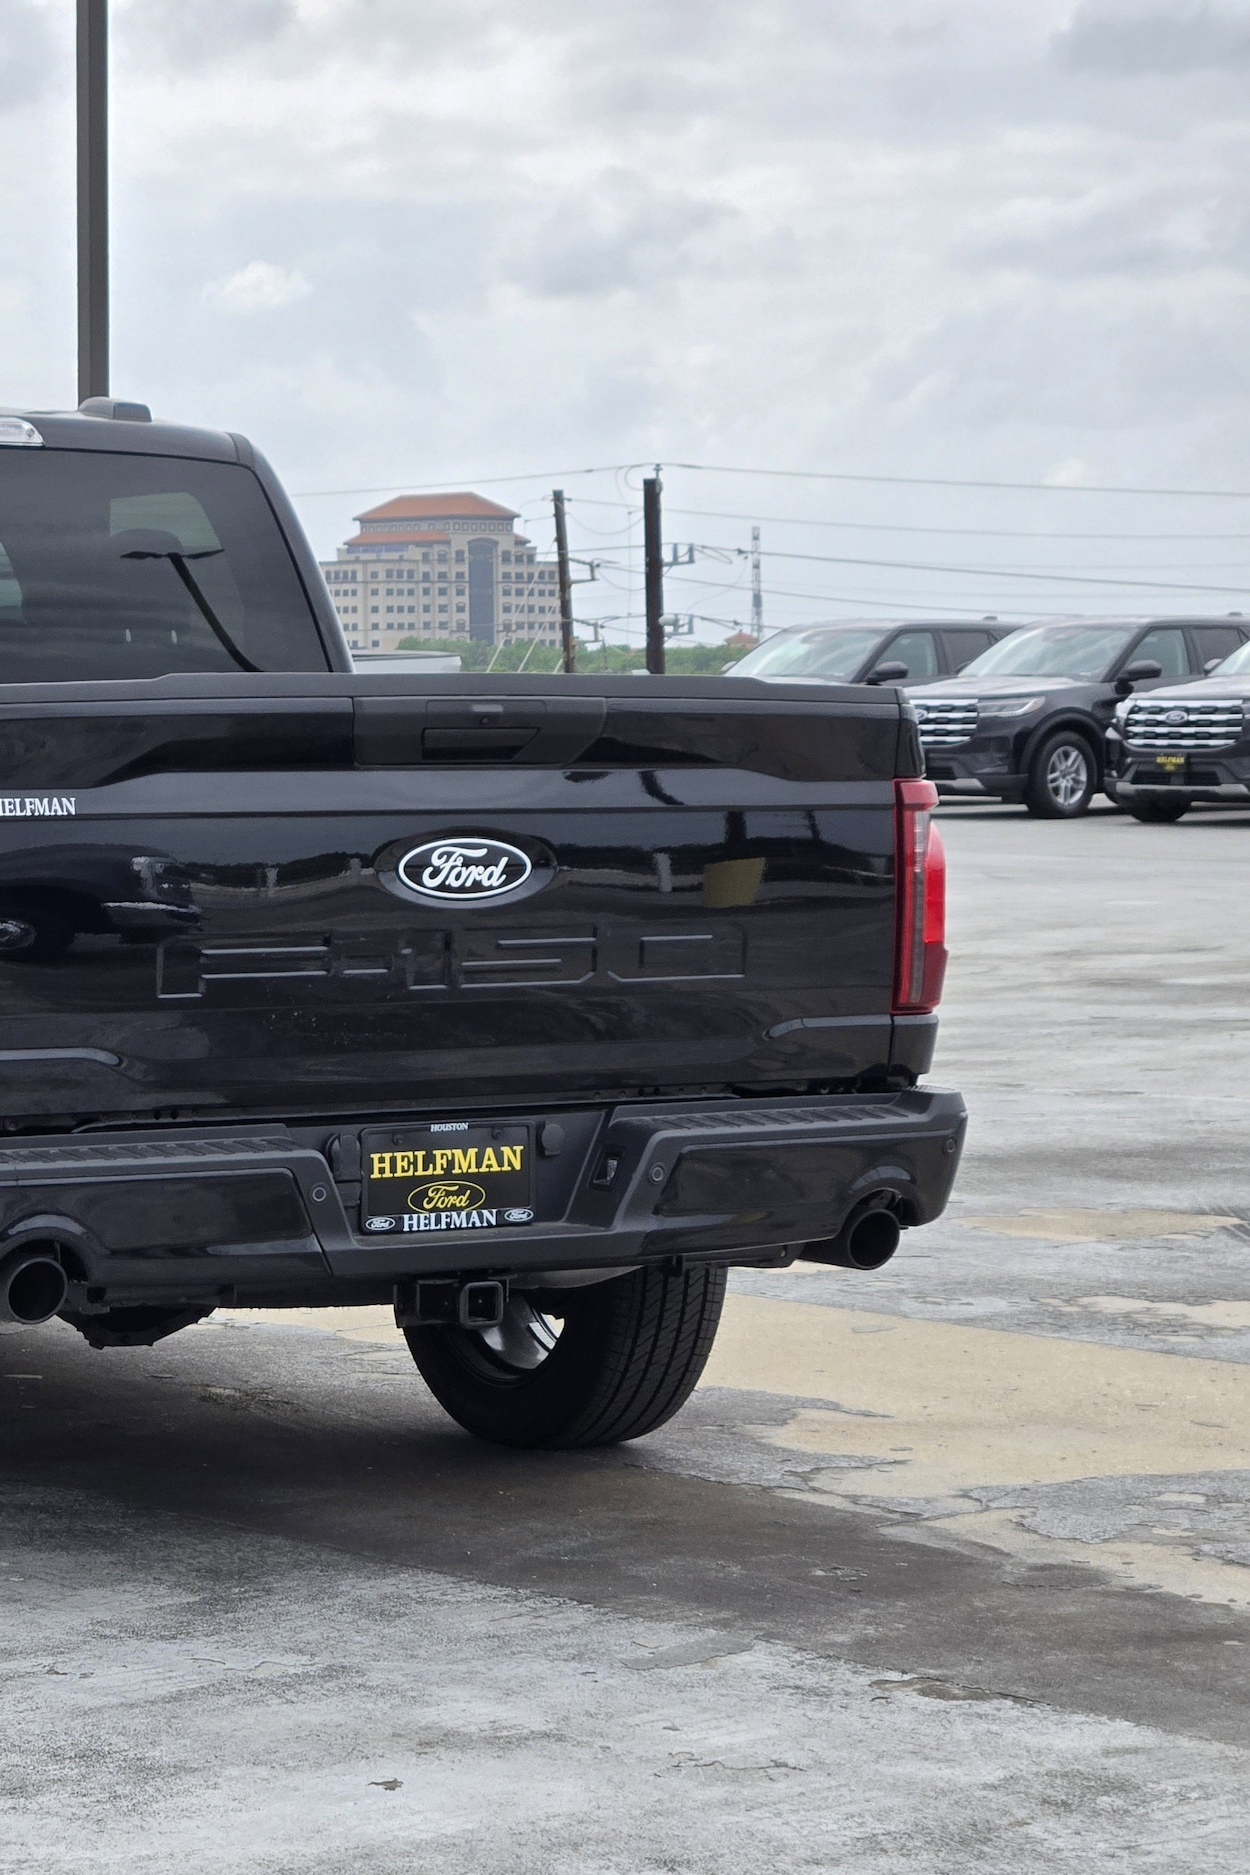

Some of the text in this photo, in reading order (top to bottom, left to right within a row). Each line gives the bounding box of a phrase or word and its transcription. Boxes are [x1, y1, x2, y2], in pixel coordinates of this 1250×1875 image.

[422, 845, 508, 888] Ford
[157, 928, 747, 998] F-150
[430, 1122, 469, 1132] HOUSTON
[370, 1145, 524, 1179] HELFMAN
[423, 1185, 471, 1209] Ford
[402, 1209, 497, 1232] HELFMAN
